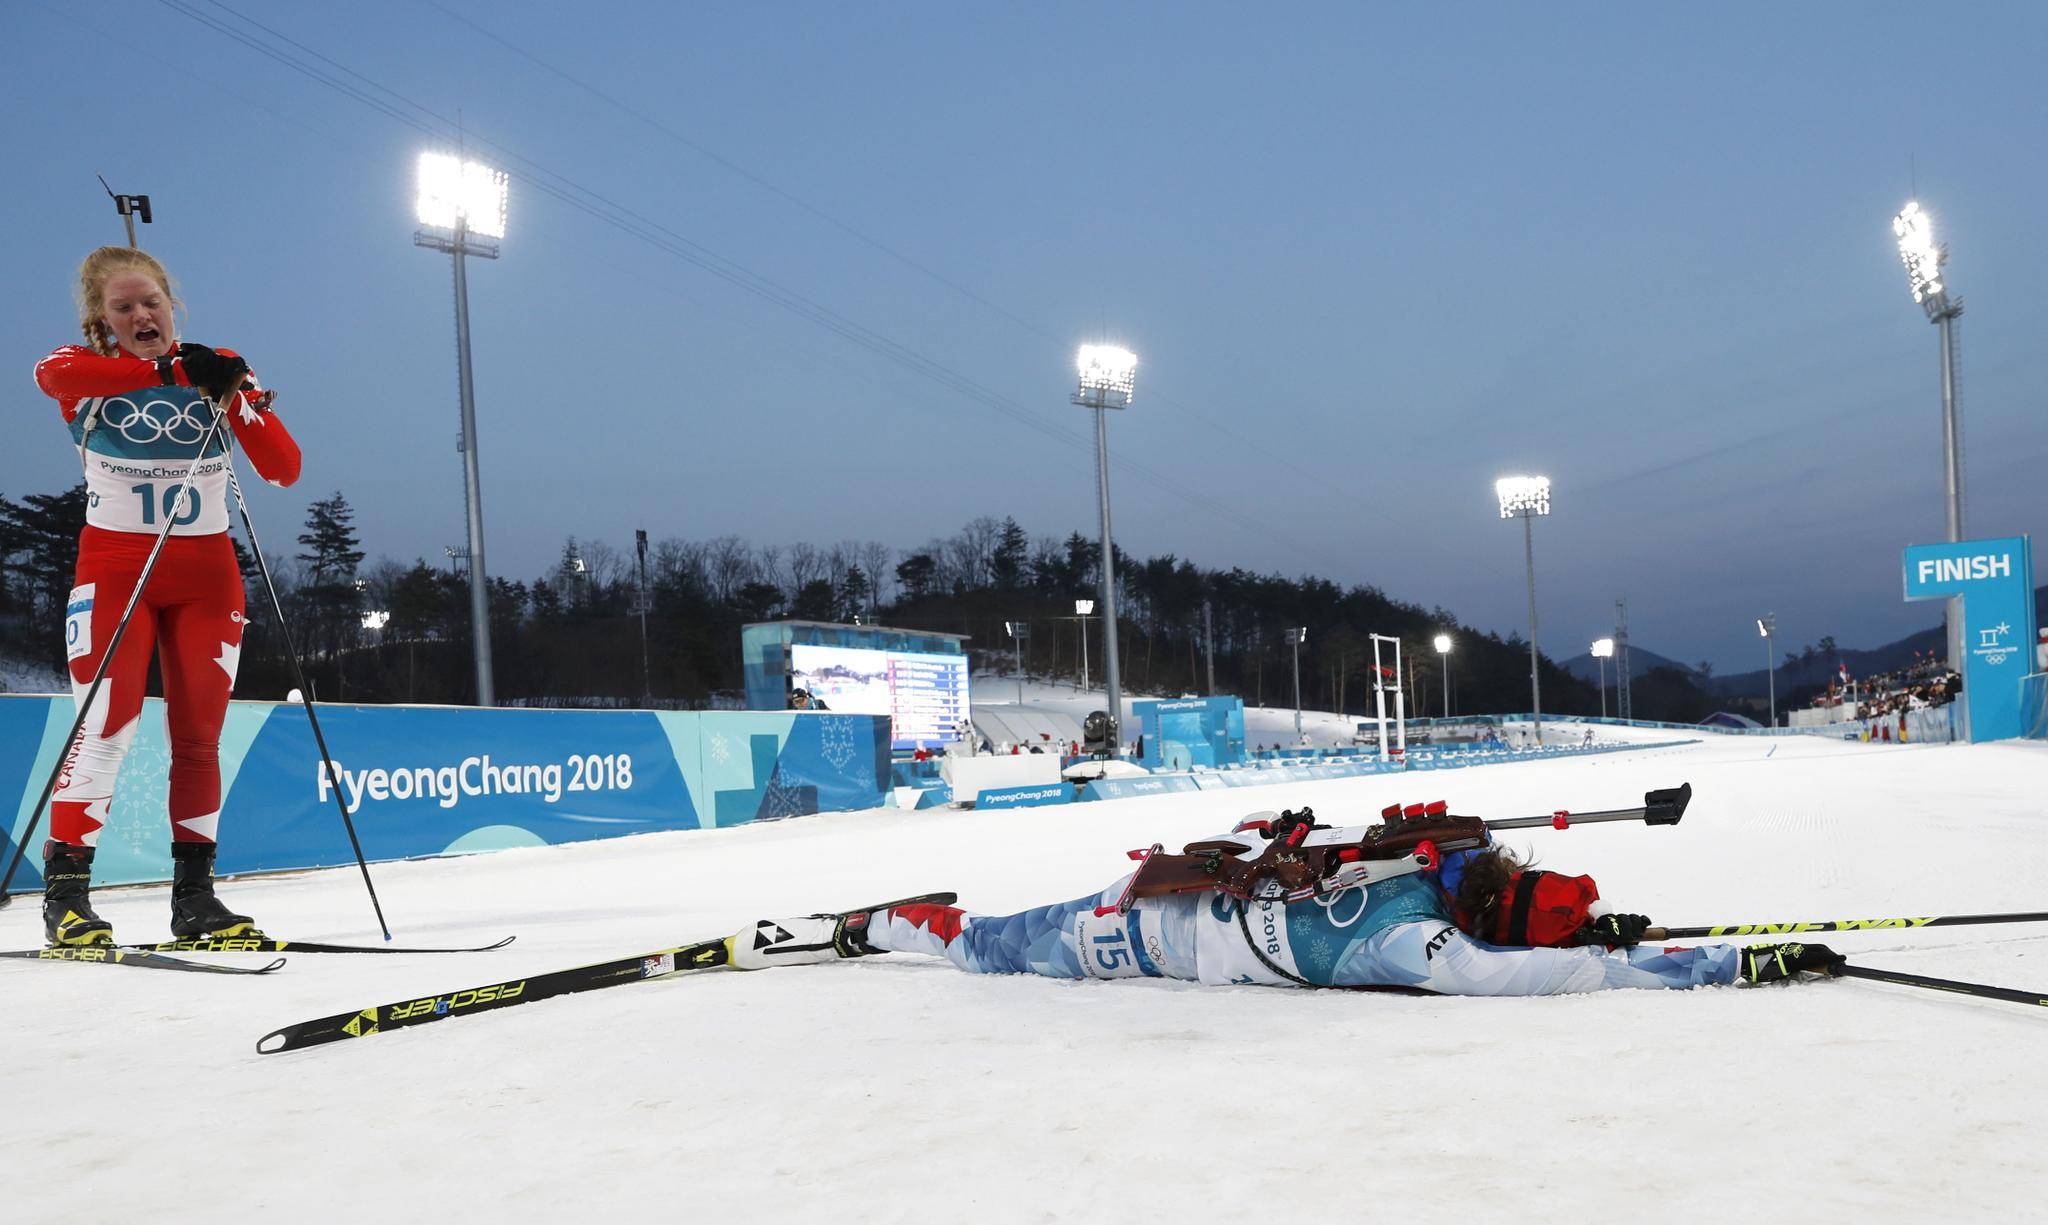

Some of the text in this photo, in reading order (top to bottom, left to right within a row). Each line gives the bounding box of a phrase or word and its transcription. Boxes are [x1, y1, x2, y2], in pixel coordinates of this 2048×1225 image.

[101, 461, 223, 478] PyeongChan 2018
[132, 482, 202, 526] 10
[1918, 553, 2010, 584] FINISH
[317, 753, 633, 814] PyeongChang 2018
[985, 788, 1062, 804] PyeongChang 2018
[1263, 913, 1281, 955] 2018
[1708, 916, 1943, 937] ONE WAY
[39, 949, 107, 963] FISCHER
[155, 938, 263, 952] FISCHER
[1093, 927, 1131, 970] 15
[398, 981, 526, 1020] FISCHER
